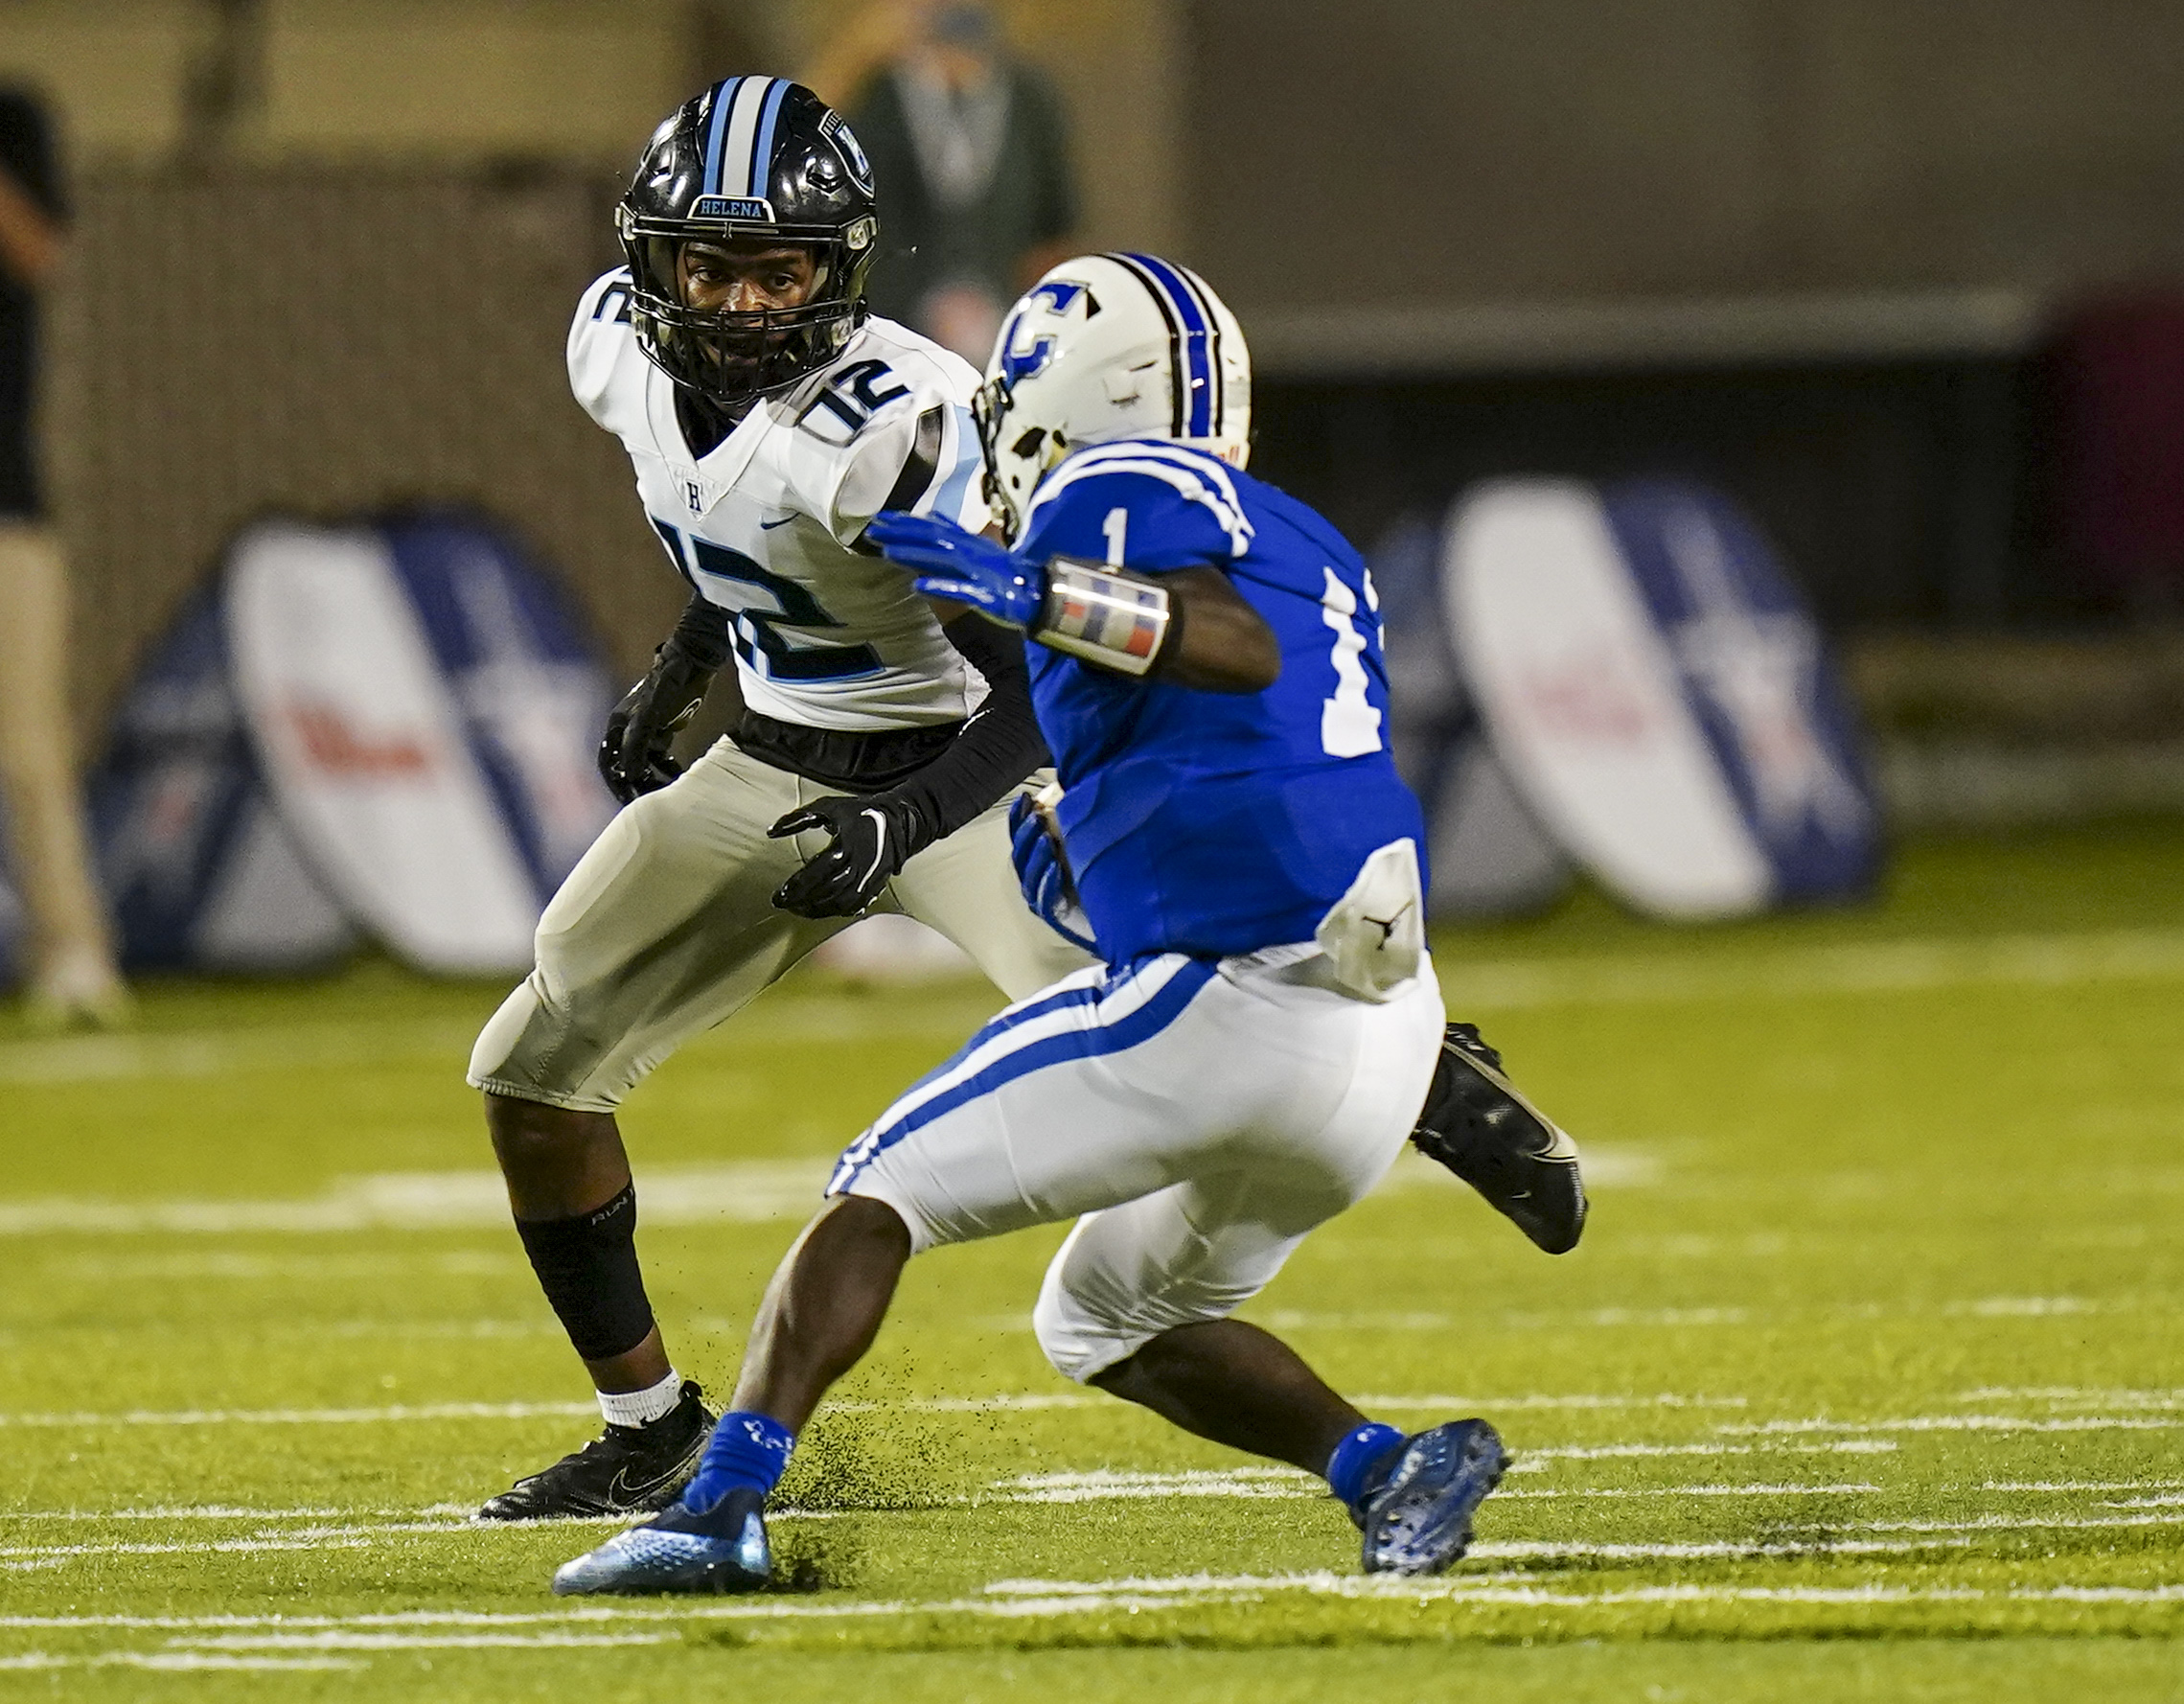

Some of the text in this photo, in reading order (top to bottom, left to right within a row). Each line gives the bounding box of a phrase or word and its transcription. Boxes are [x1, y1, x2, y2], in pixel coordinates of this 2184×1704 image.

[700, 199, 762, 218] HELENA
[686, 481, 702, 513] H
[1102, 507, 1128, 569] 1
[1321, 566, 1385, 758] 1
